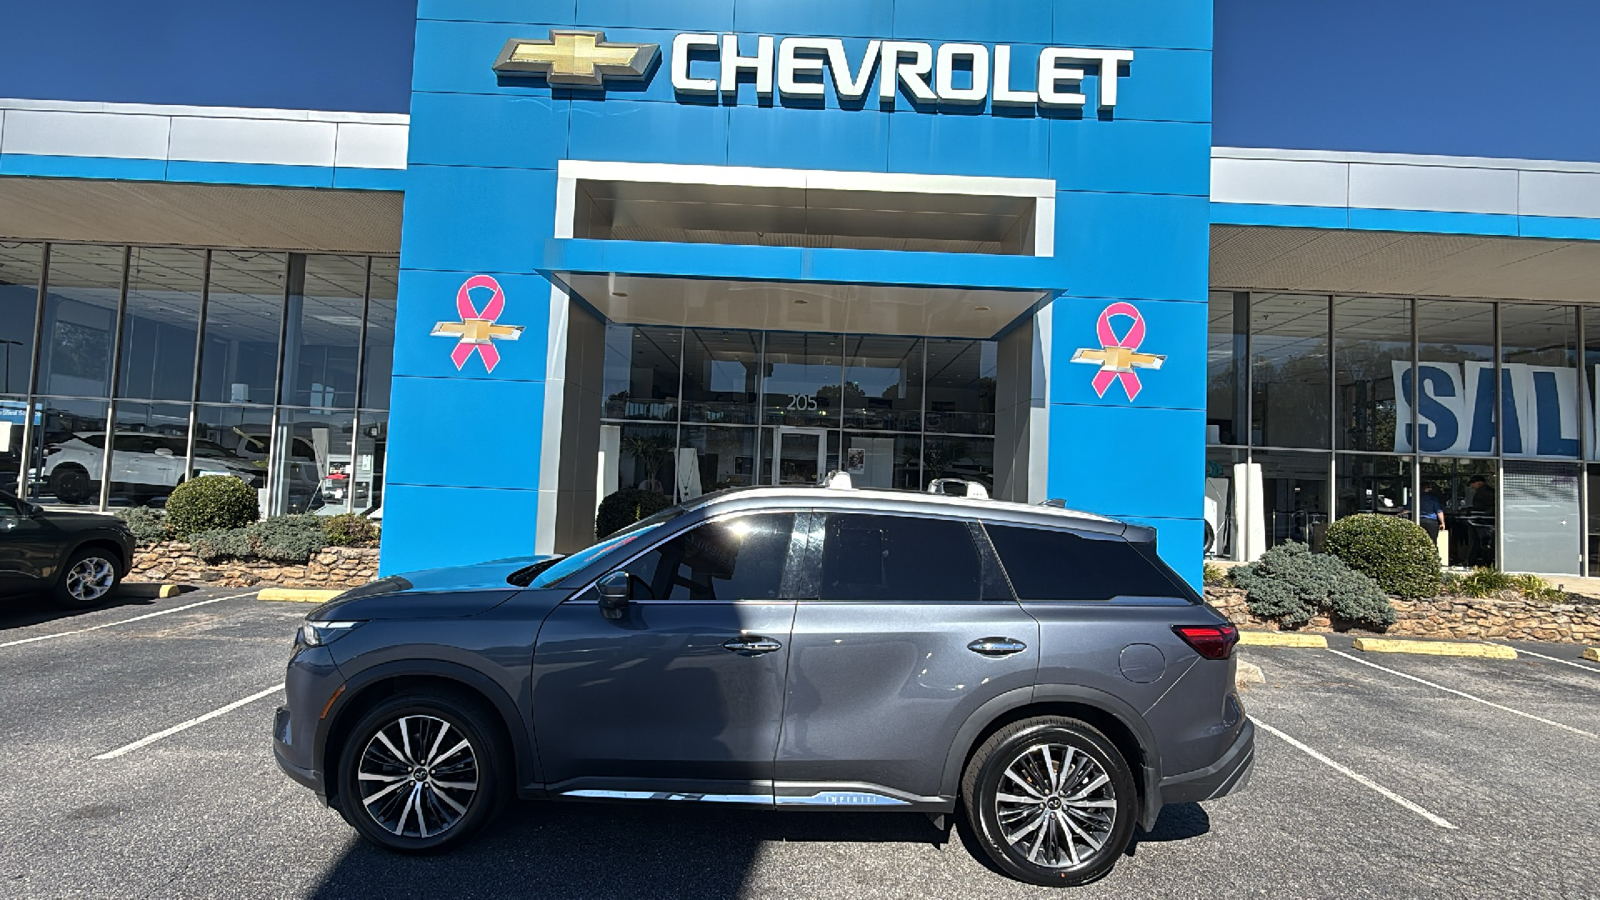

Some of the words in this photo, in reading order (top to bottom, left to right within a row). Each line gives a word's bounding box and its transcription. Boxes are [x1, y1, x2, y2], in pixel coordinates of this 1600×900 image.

[671, 32, 1134, 108] CHEVROLET
[787, 394, 818, 410] 205
[825, 796, 877, 804] INFINITI
